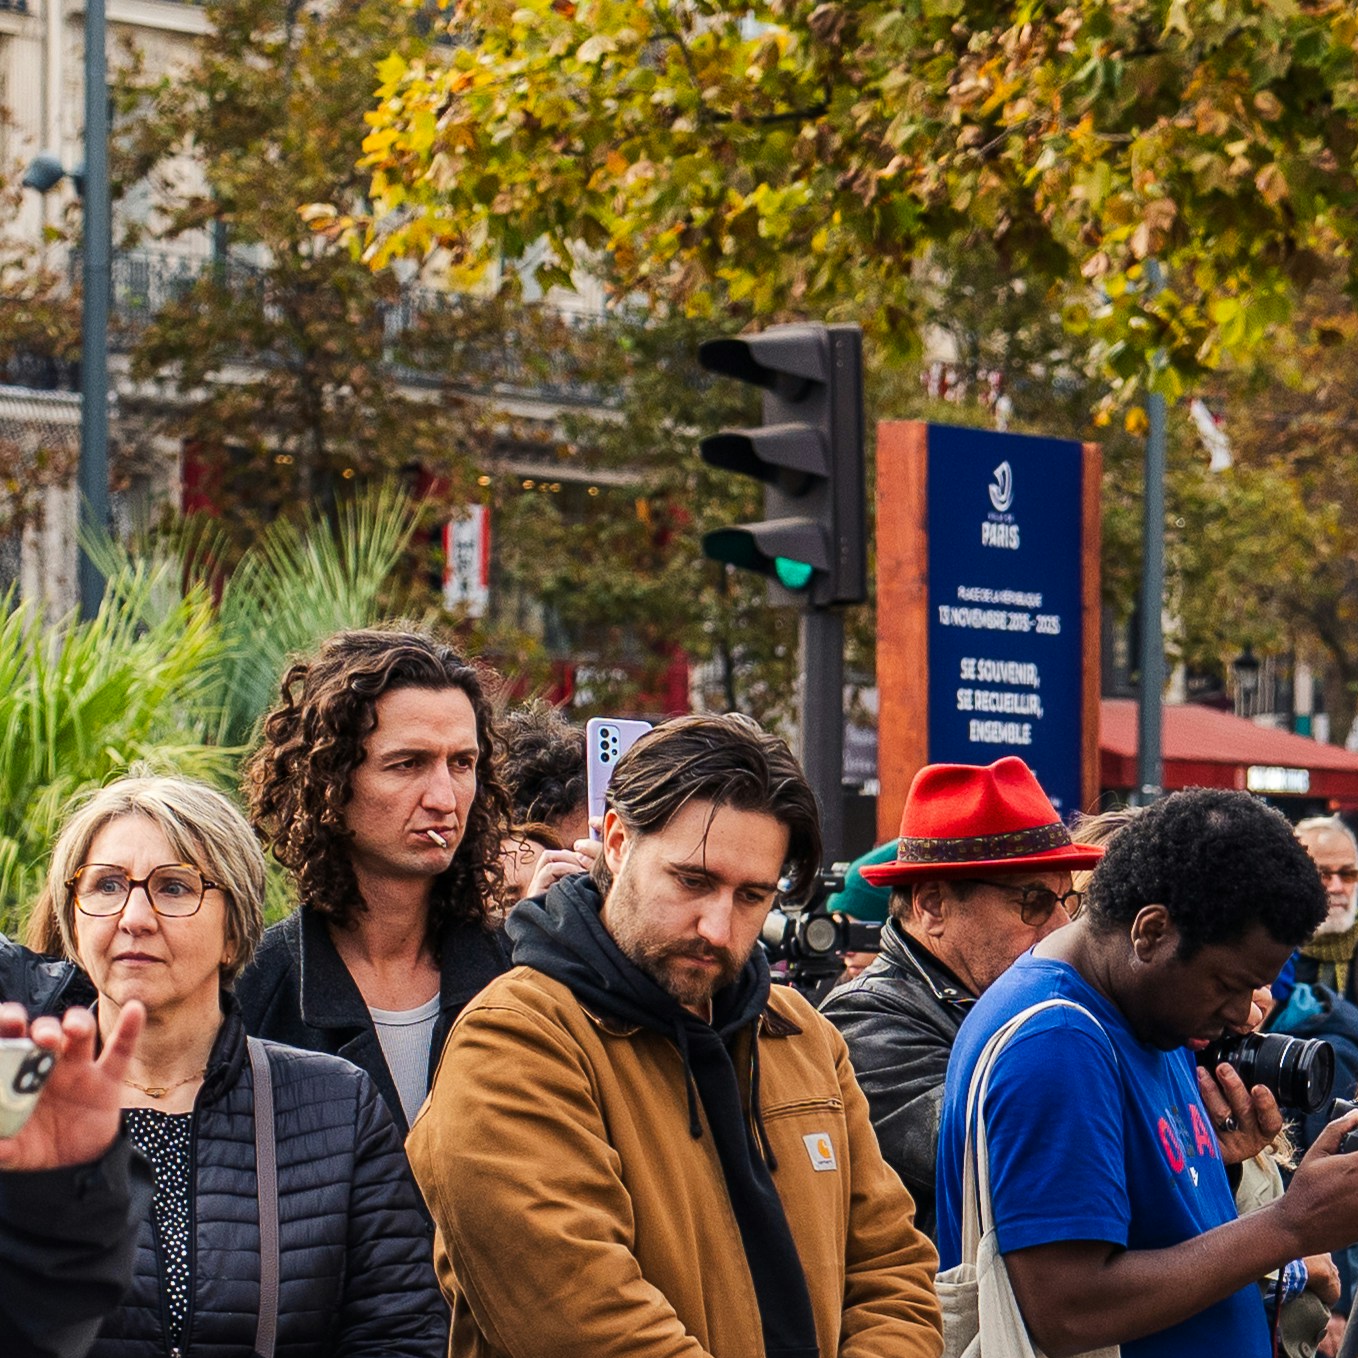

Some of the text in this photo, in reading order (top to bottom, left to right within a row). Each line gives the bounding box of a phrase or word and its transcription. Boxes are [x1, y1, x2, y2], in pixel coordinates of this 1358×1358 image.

[982, 521, 1020, 550] PARIS
[939, 605, 950, 626] 13
[950, 607, 1007, 630] NOVEMBRE
[1007, 611, 1030, 632] 2015
[960, 657, 1040, 689] SE SOUVENIR,
[957, 688, 1043, 720] SE RECUEILLIR,
[969, 719, 1032, 745] ENSEMBLE
